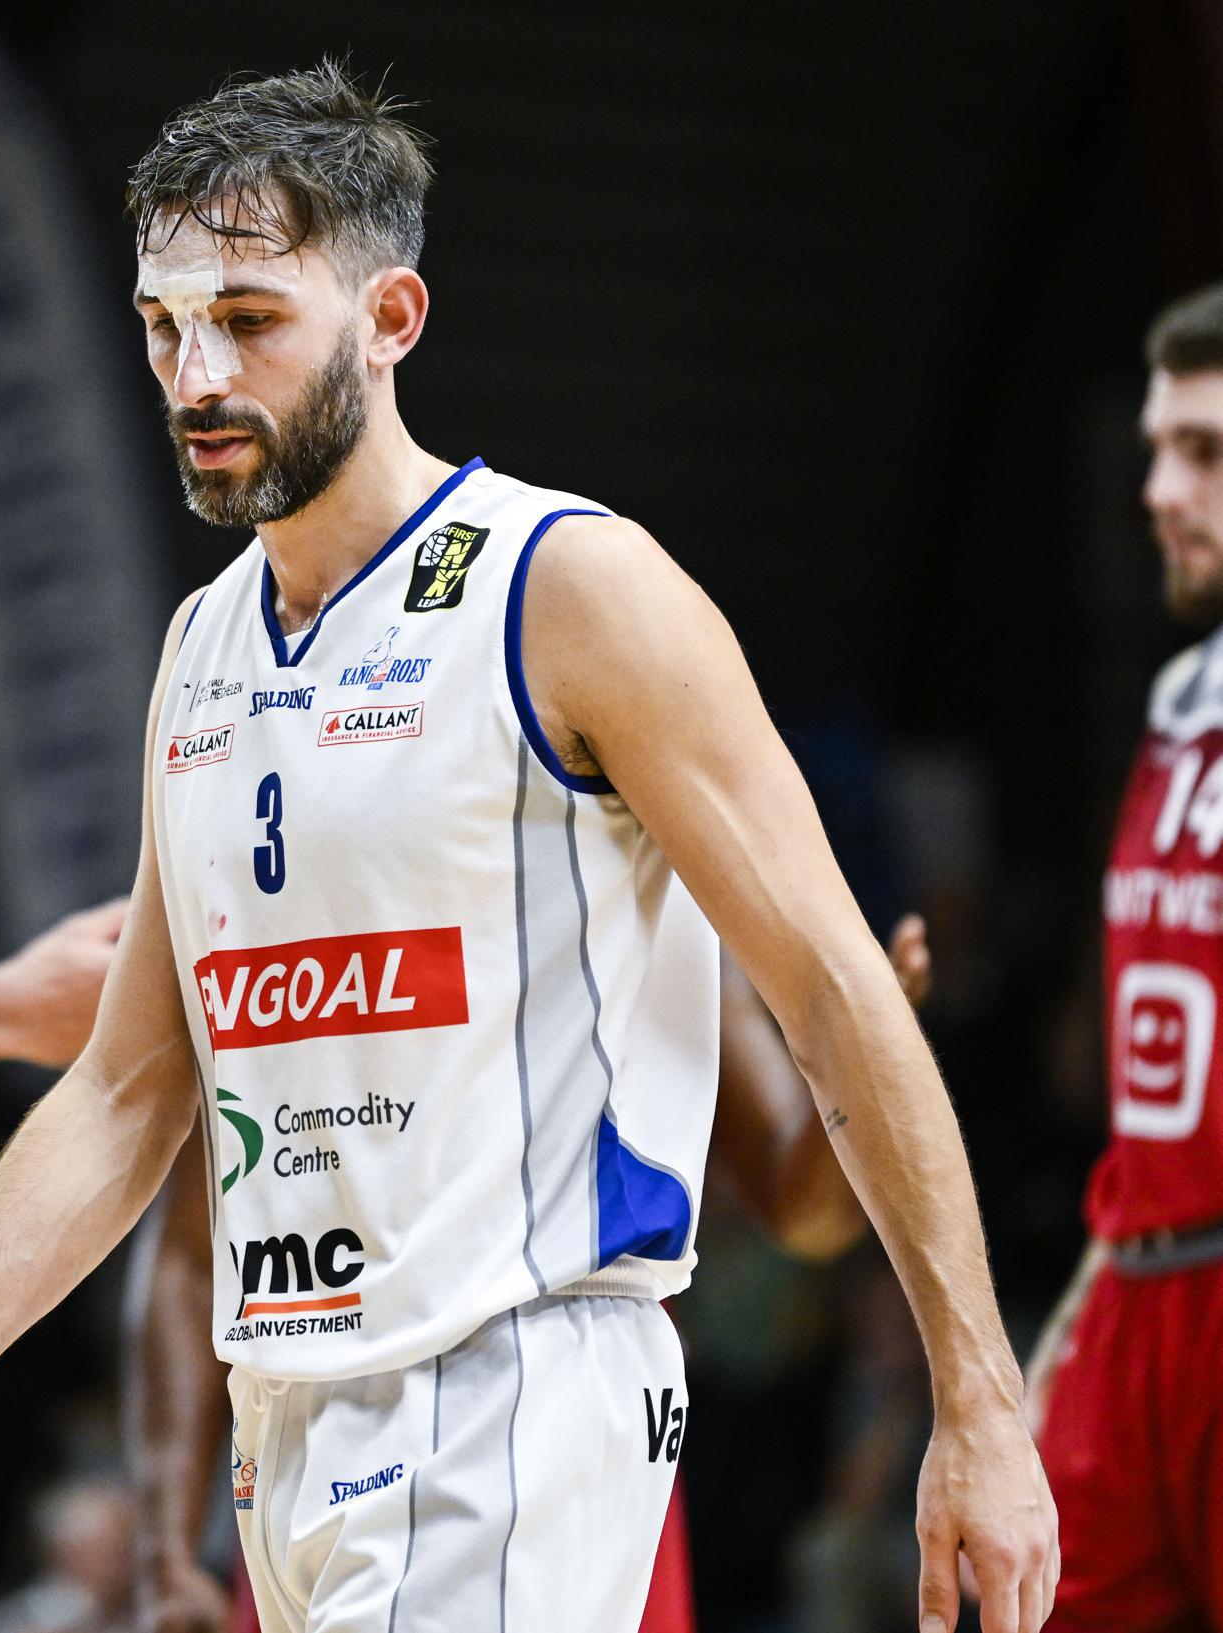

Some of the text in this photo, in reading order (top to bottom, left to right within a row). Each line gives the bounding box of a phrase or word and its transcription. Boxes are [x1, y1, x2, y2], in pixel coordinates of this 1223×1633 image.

[249, 686, 316, 717] SPALDING
[345, 707, 419, 731] CALLANT
[254, 771, 286, 894] 3
[275, 1092, 415, 1135] Commodity
[274, 1146, 340, 1177] Centre
[255, 1312, 363, 1338] INVESTMENT
[329, 1464, 403, 1505] SPALDING
